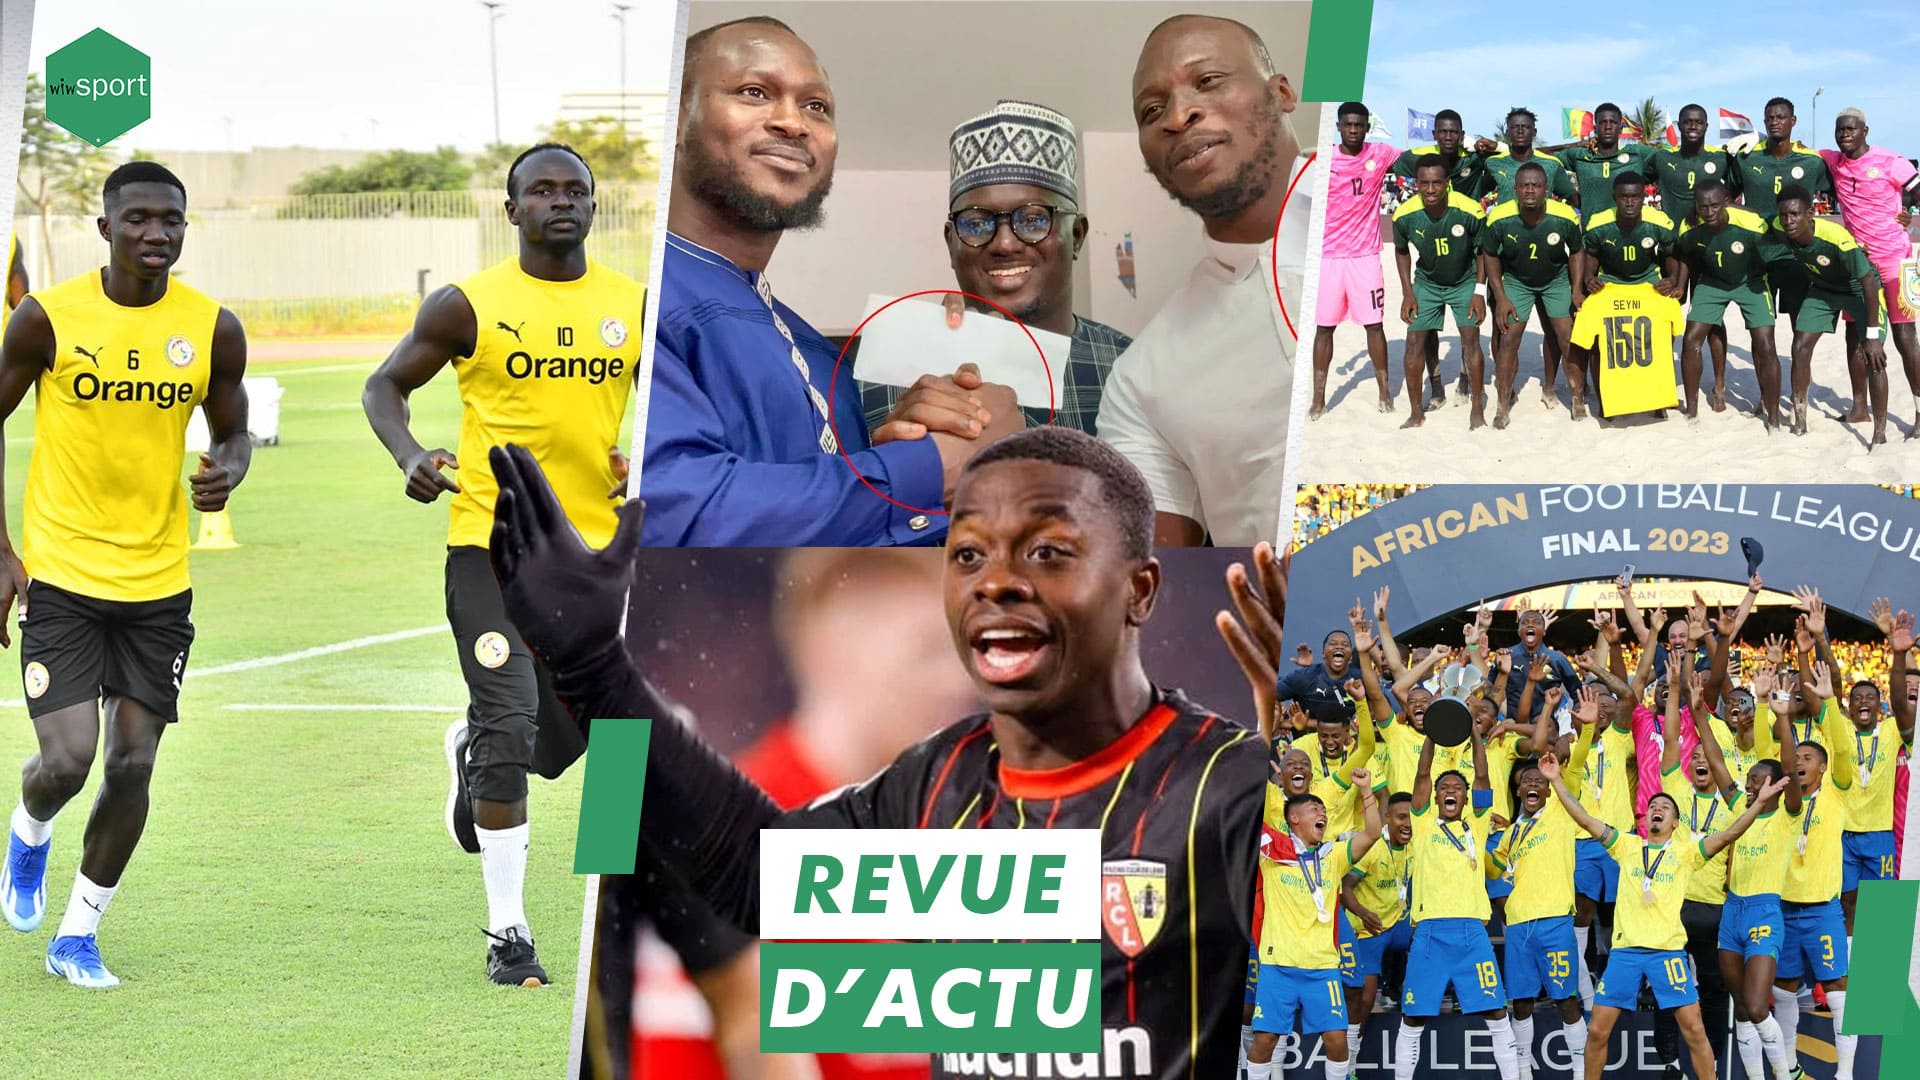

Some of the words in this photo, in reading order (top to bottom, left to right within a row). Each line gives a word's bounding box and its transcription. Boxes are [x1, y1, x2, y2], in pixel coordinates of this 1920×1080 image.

[1602, 161, 1610, 179] 8
[1687, 170, 1695, 190] 9
[1351, 177, 1364, 196] 12
[1774, 175, 1782, 195] 5
[1434, 237, 1449, 257] 15
[1529, 243, 1538, 260] 2
[1623, 245, 1636, 262] 10
[1715, 250, 1723, 269] 7
[1613, 299, 1641, 310] SEYNI
[557, 326, 573, 347] 10
[1603, 315, 1653, 370] 150
[128, 349, 140, 370] 6
[506, 351, 624, 385] Orange
[73, 372, 193, 409] Orange
[1352, 492, 1529, 578] AFRICAN
[1539, 484, 1759, 517] FOOTBALL
[1541, 527, 1640, 560] FINAL
[1647, 527, 1730, 555] 2023
[1599, 590, 1657, 601] AFRCAN
[172, 651, 184, 674] 6
[1880, 854, 1894, 878] 14
[1105, 881, 1137, 947] RCL
[1819, 934, 1835, 961] 3
[1475, 960, 1498, 989] 18
[1546, 950, 1570, 978] 35
[1663, 957, 1688, 985] 10
[1326, 980, 1342, 1008] 11
[1430, 1029, 1667, 1071] LEGUE
